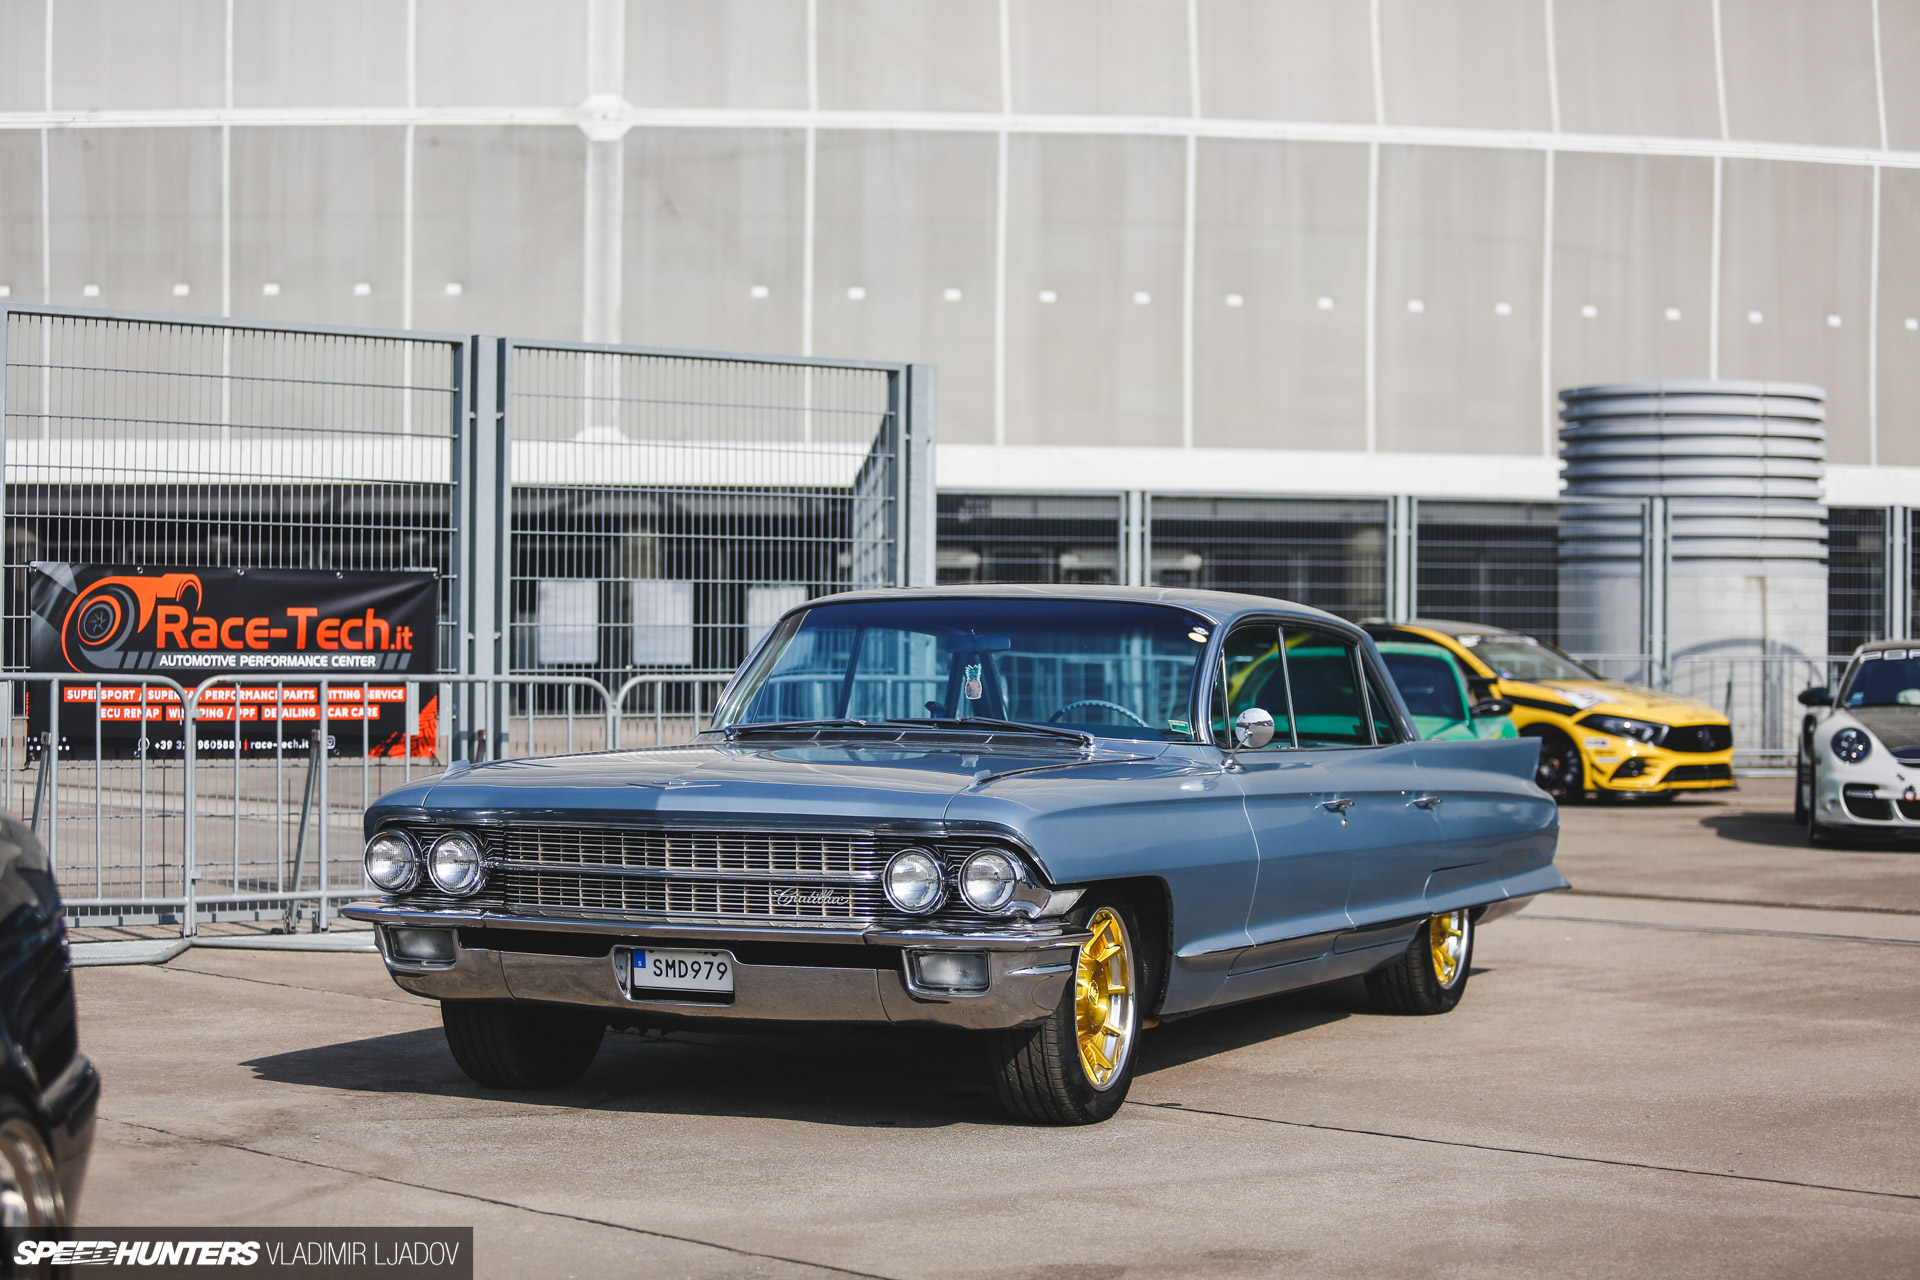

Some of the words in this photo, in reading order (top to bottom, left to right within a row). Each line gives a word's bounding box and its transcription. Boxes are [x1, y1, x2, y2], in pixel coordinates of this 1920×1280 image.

[156, 604, 414, 651] Race-Tech.it
[159, 653, 237, 668] AUTOMOTIVE
[239, 654, 329, 668] PERFORMANCE
[331, 655, 377, 668] CENTER
[67, 689, 136, 700] SUPESPORT
[147, 689, 203, 700] SUPERA
[283, 689, 315, 700] PARTS
[325, 689, 361, 700] ITTING
[100, 708, 121, 718] ECU
[168, 708, 224, 718] WRPING
[264, 707, 316, 718] DEAILING
[327, 706, 349, 718] CAR
[197, 739, 242, 750] 960588
[250, 738, 309, 750] race-ech.it
[653, 958, 728, 981] SMD979
